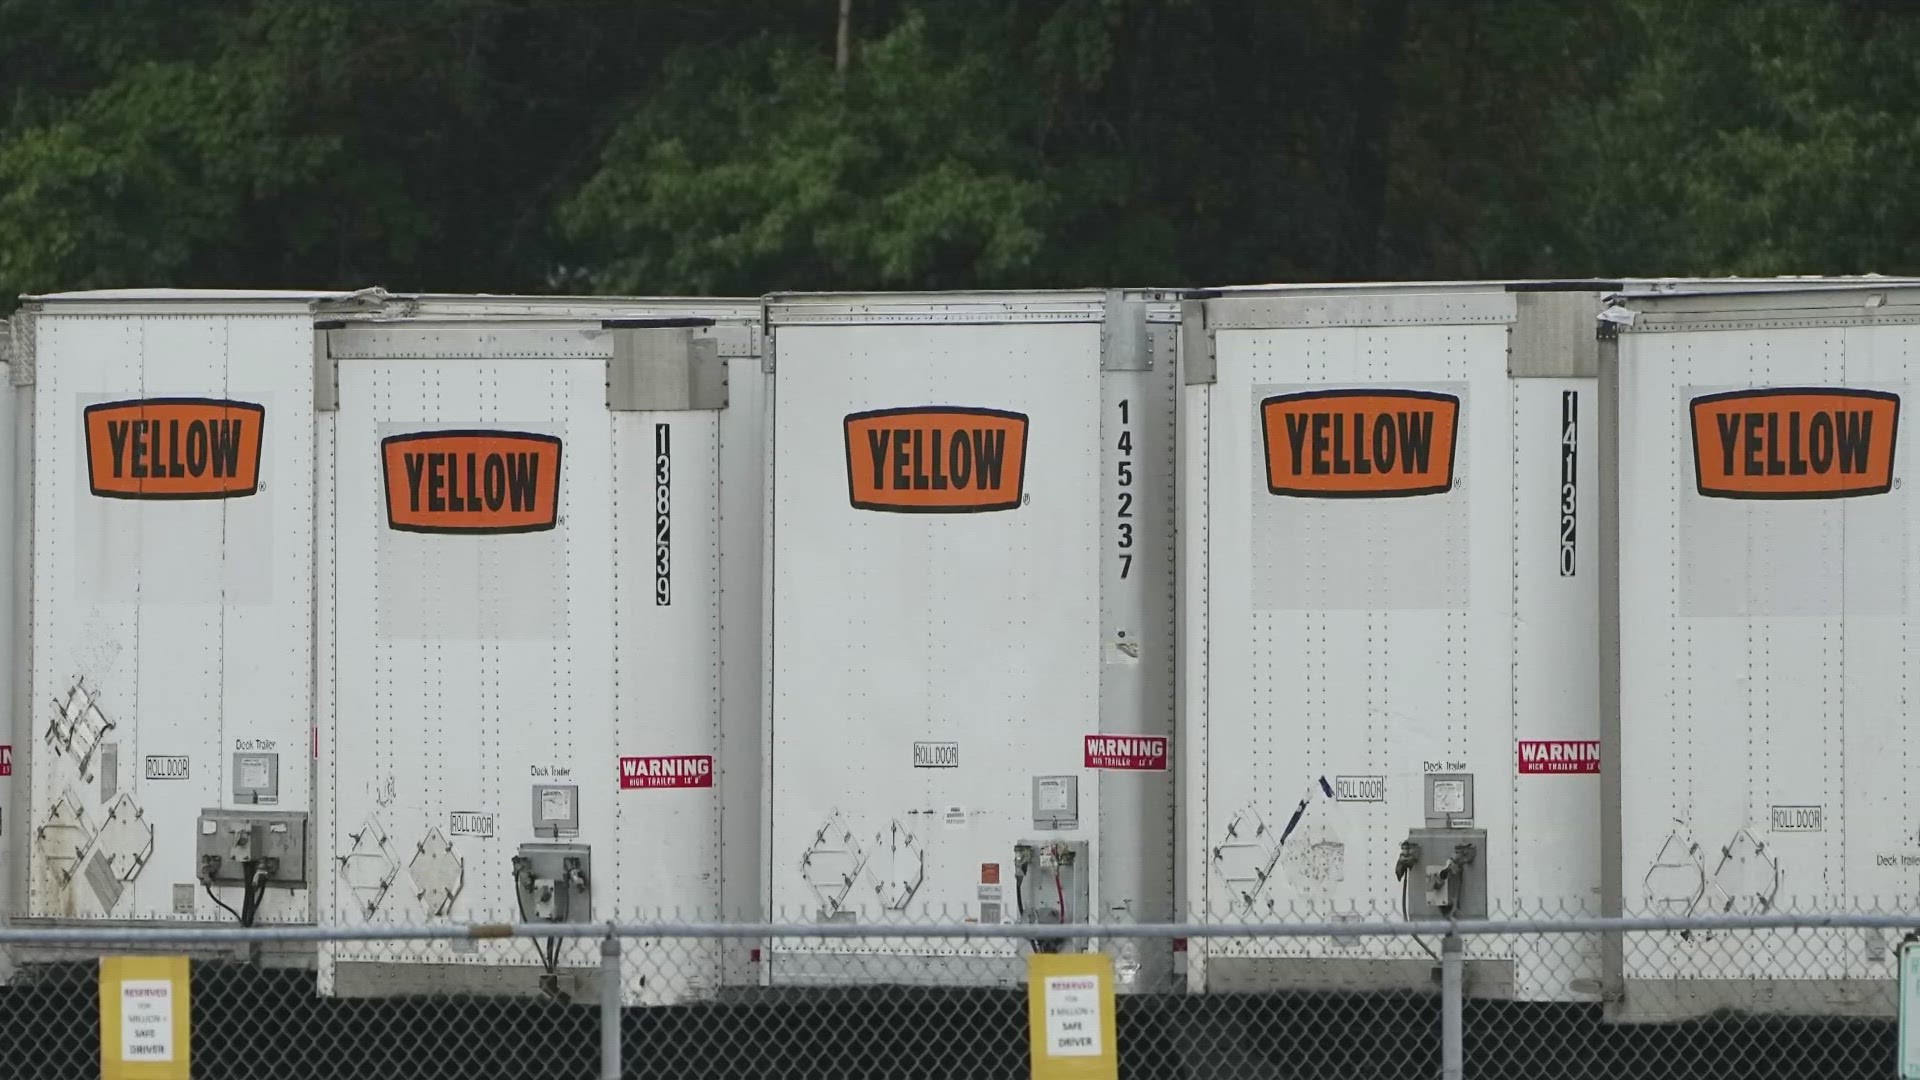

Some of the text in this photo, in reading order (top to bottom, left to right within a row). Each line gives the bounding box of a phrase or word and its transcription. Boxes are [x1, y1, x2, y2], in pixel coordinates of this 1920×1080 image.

[108, 420, 242, 478] YELLOW
[1285, 411, 1434, 476] YELLOW
[1716, 410, 1873, 476] YELLOW
[867, 430, 1006, 490] YELLOW
[404, 453, 539, 512] YELLOW
[1117, 399, 1133, 580] 145237
[1561, 391, 1577, 576] 141320
[656, 424, 670, 605] 138239
[255, 739, 277, 750] Trailer
[1087, 739, 1163, 758] WARNING
[1521, 742, 1600, 762] WARNIN
[915, 745, 957, 764] ROLL DOOR
[1104, 758, 1131, 767] TRAILER
[147, 758, 188, 776] ROLL DOOR
[622, 757, 709, 777] WARNING
[1548, 762, 1578, 771] TRAILER
[629, 777, 644, 787] HIGH
[647, 776, 676, 787] TRAILER
[1337, 780, 1382, 798] ROLL DOOR
[452, 815, 492, 834] ROLL DOOR
[1773, 809, 1820, 828] ROLL DOOR
[1876, 855, 1920, 866] Deck Traile
[124, 988, 168, 998] RESERVED
[1051, 981, 1094, 991] RESERVED
[134, 1029, 156, 1039] SAFE
[1062, 1021, 1082, 1031] SAFE
[129, 1044, 165, 1055] DRIVER
[1058, 1037, 1093, 1048] DRIVER
